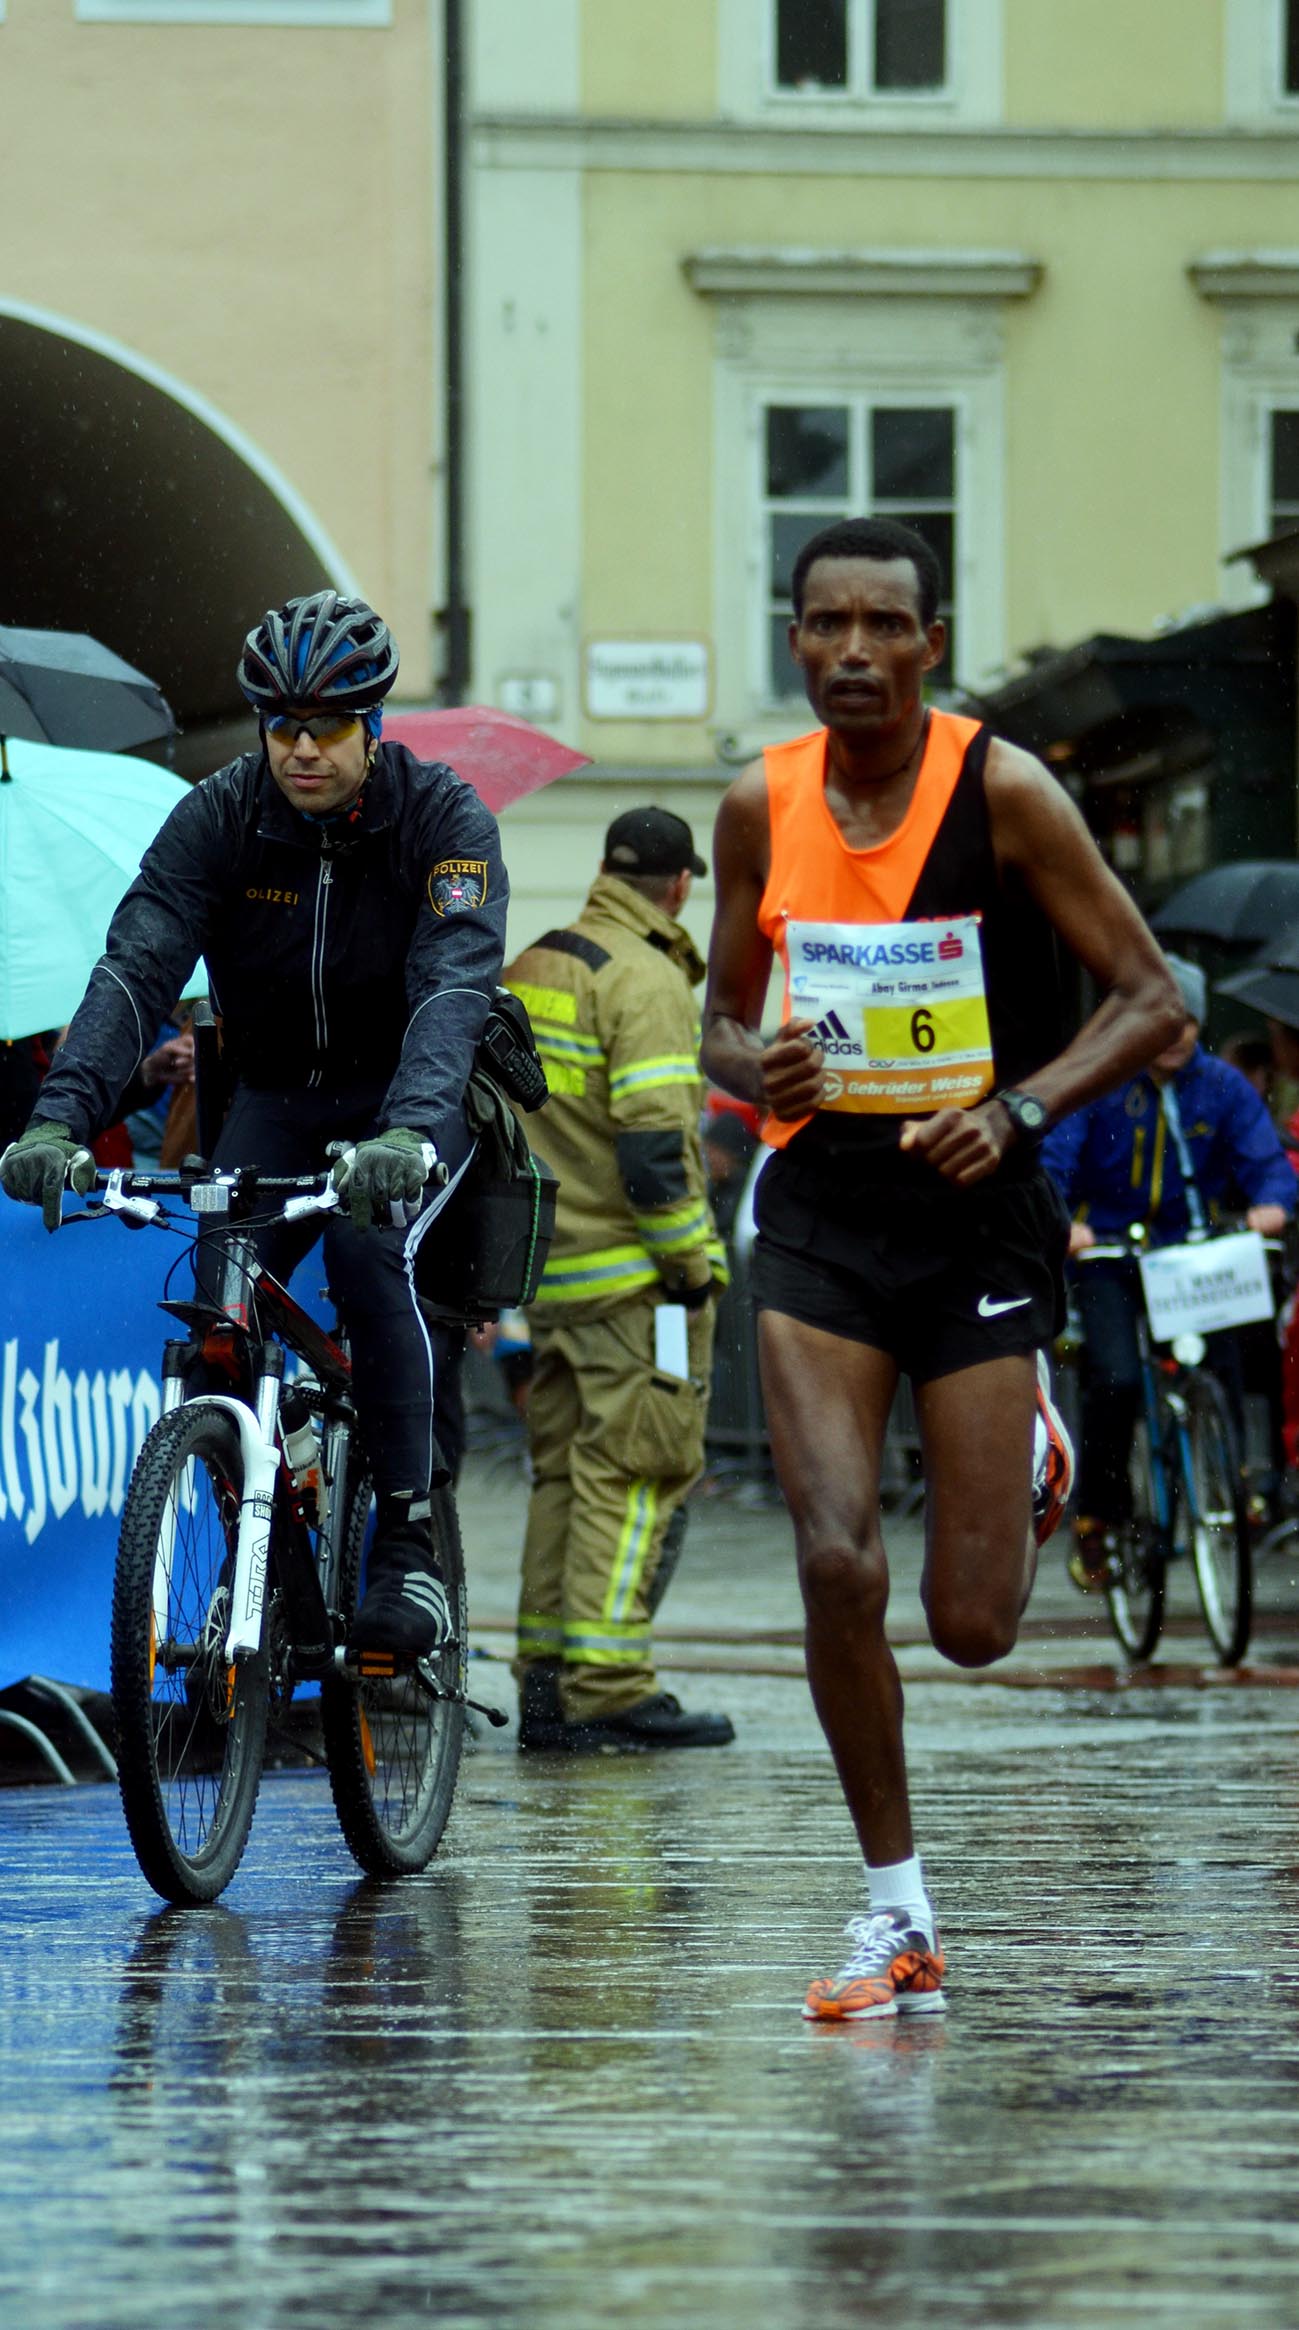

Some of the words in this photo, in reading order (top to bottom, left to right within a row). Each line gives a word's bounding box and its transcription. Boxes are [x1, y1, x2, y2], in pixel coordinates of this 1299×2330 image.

[432, 863, 482, 877] POLIZEI
[244, 887, 299, 906] OLIZEI
[802, 941, 935, 966] SPARKASSE
[910, 1008, 936, 1054] 6
[812, 1039, 864, 1057] didas
[847, 1079, 926, 1097] Gebrüder
[931, 1073, 984, 1094] Weiss
